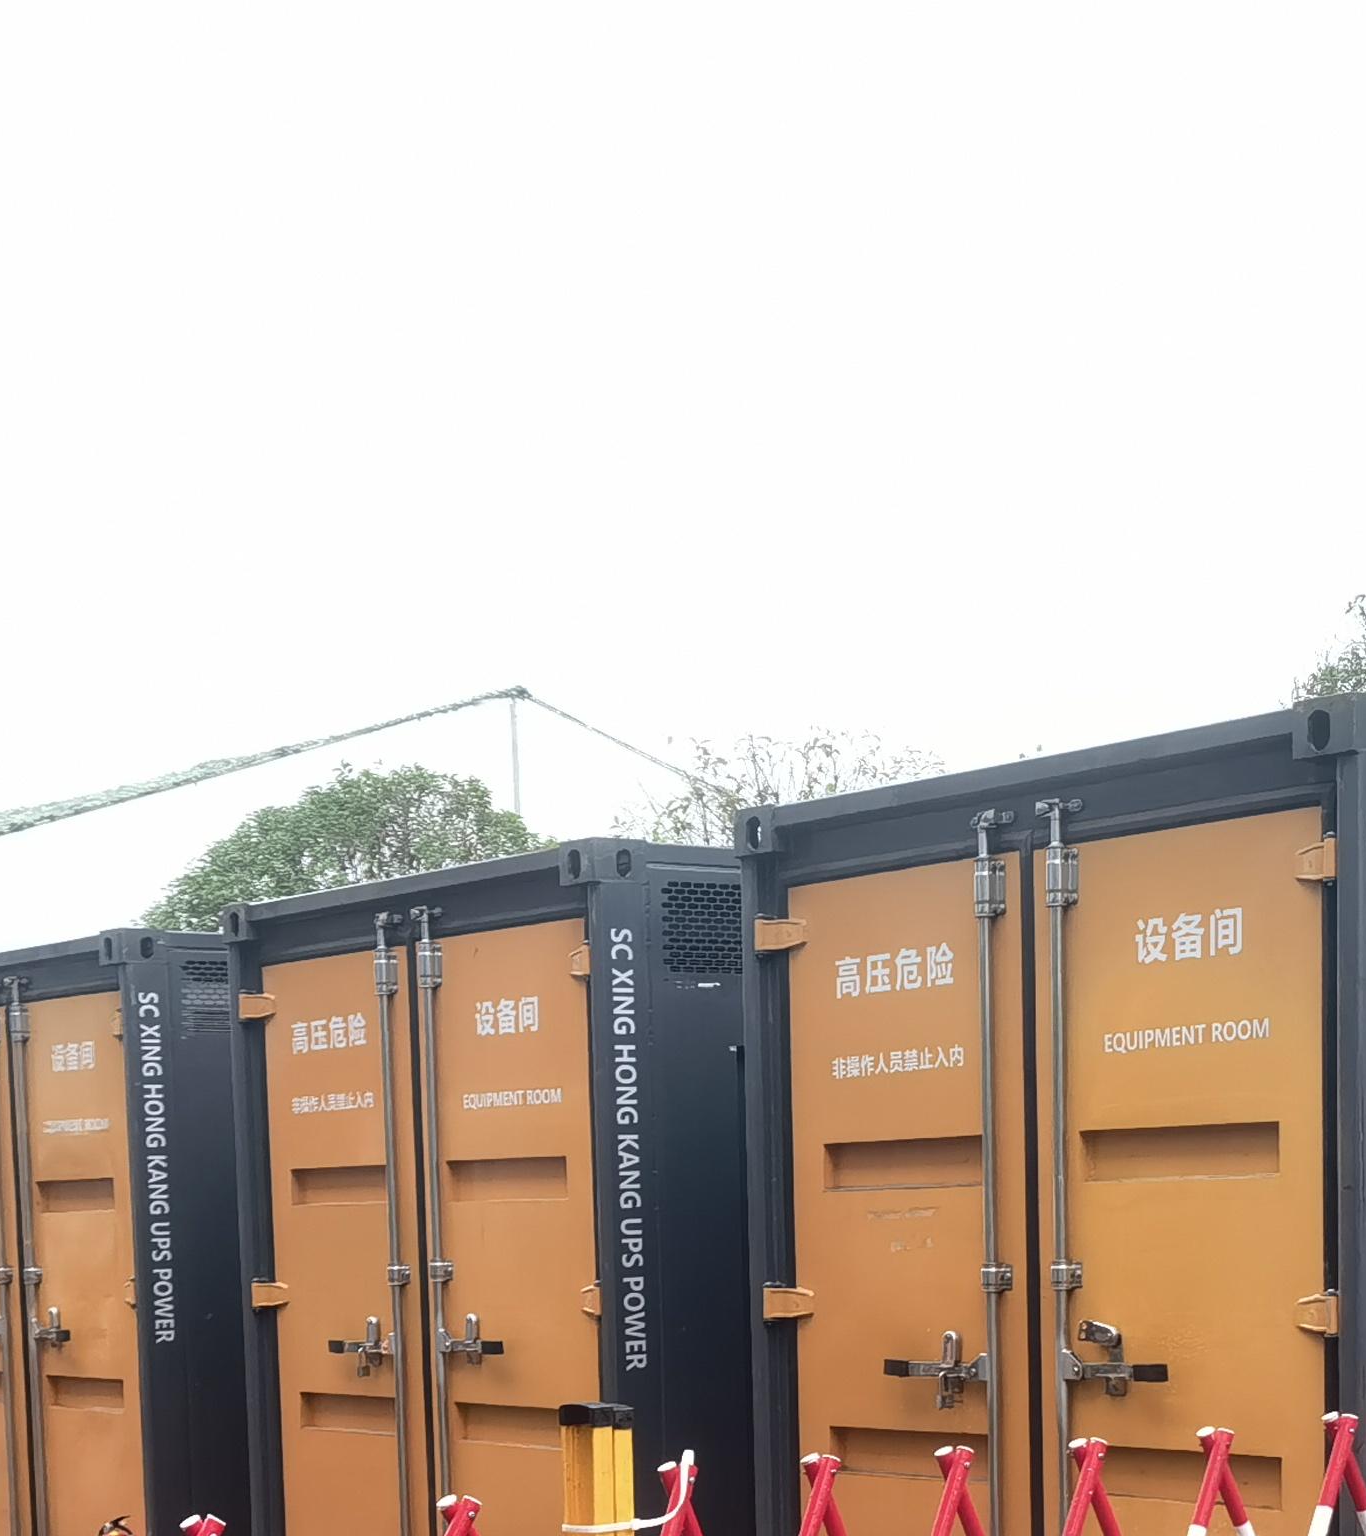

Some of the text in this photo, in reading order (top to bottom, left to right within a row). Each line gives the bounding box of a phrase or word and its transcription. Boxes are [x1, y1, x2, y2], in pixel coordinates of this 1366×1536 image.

[1134, 907, 1244, 966] 设备间
[834, 942, 955, 999] 高压危险
[290, 1012, 368, 1055] 高压危险
[474, 996, 540, 1037] 设备间
[1103, 1017, 1271, 1054] EQUIPMENT ROOM
[831, 1043, 965, 1081] 非操作人员禁止入内
[462, 1087, 563, 1110] EQUIPMENT ROOM
[137, 992, 176, 1344] SC XING HONG KANG UPS POWER
[610, 928, 648, 1371] SC XING HONG KANG UPS POWER
